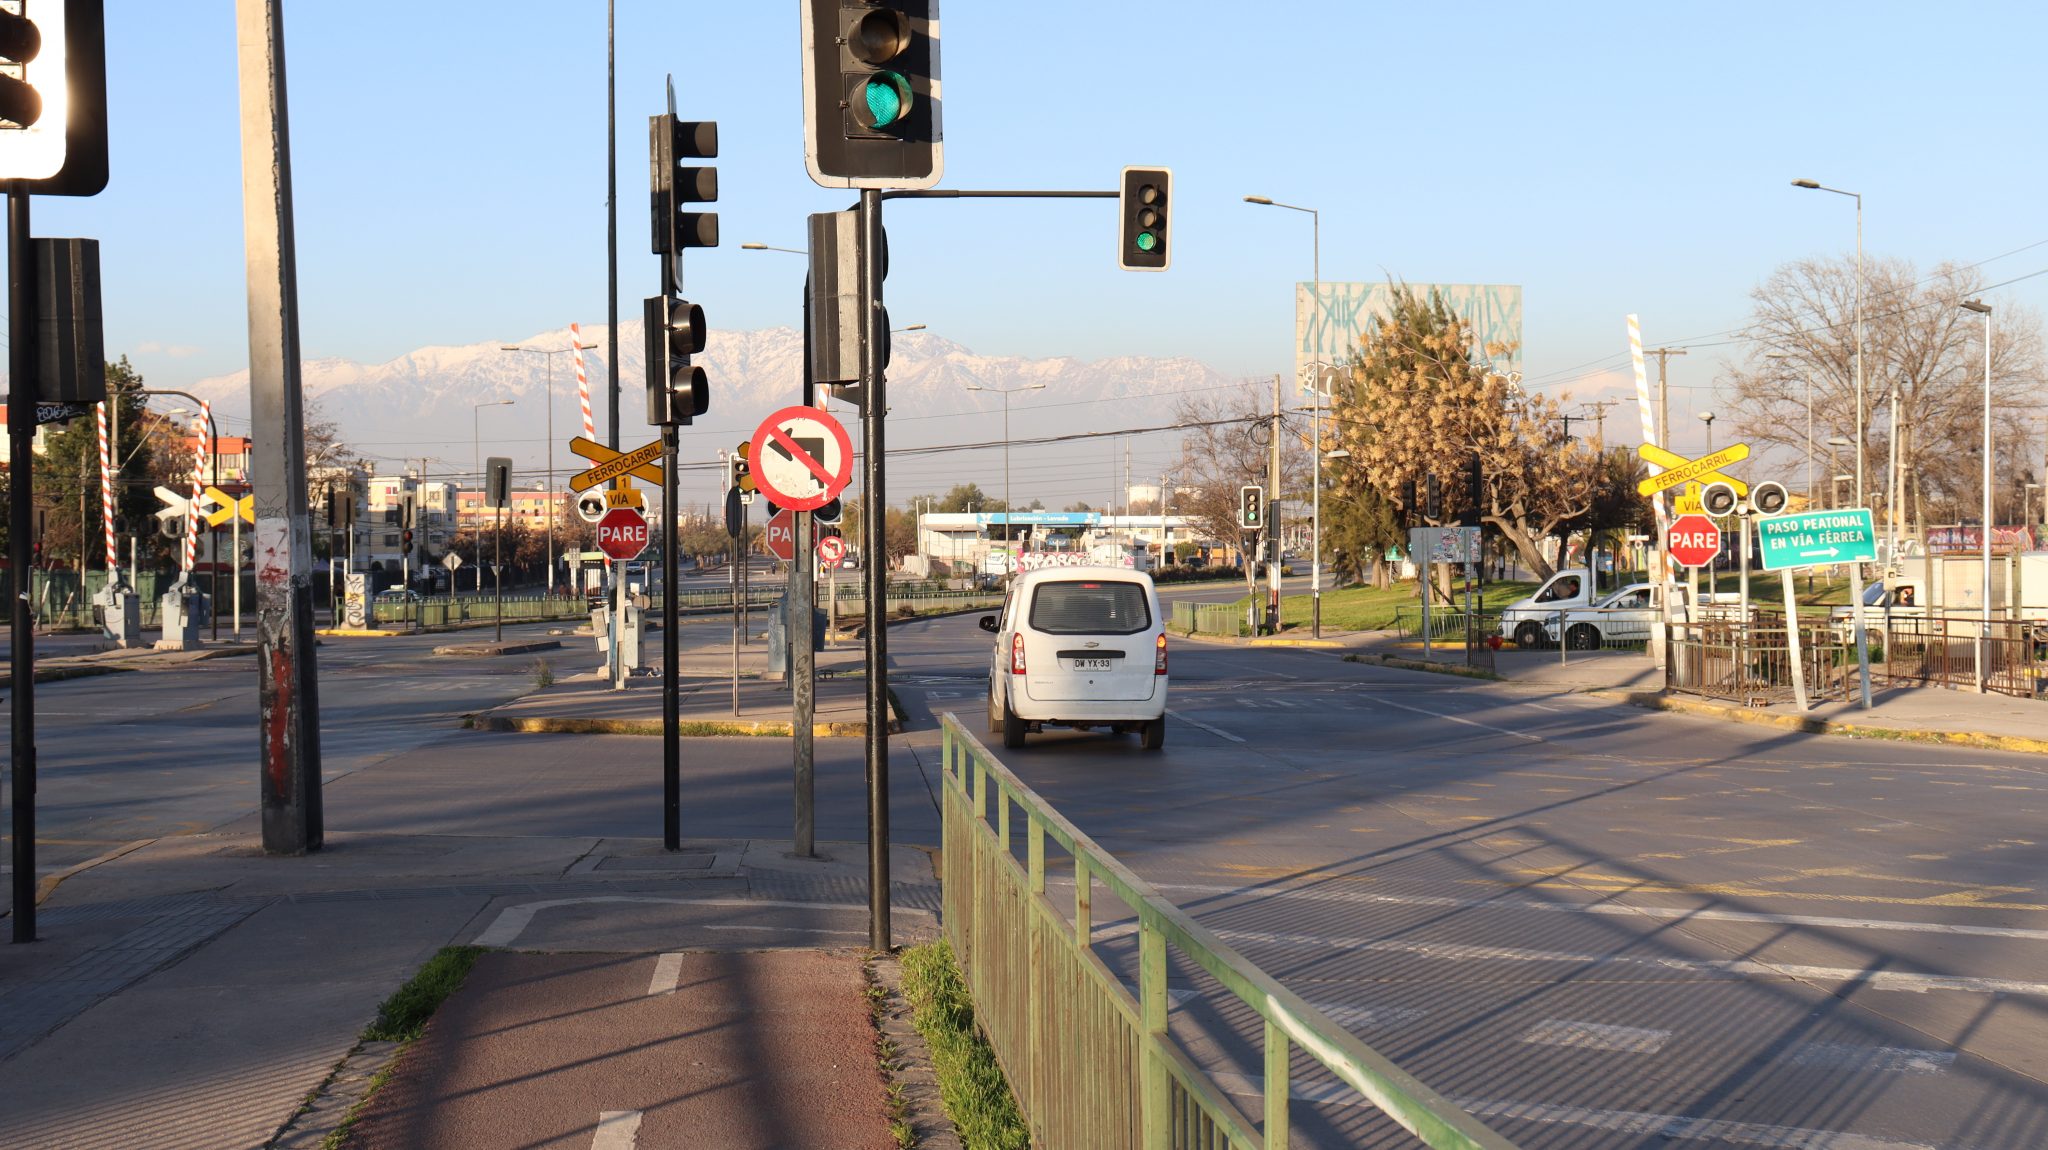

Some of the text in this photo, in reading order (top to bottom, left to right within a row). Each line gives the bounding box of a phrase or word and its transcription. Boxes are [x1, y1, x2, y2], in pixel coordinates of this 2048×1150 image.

[587, 445, 662, 484] FERROCARRIL
[1655, 453, 1732, 488] FERROCARRIL
[621, 477, 627, 488] 1
[1691, 485, 1697, 495] 1
[600, 525, 646, 543] PARE
[1767, 515, 1865, 535] PASO PEATONAL
[1670, 532, 1717, 549] PARE
[1771, 530, 1865, 550] EN VÍA FÉRREA
